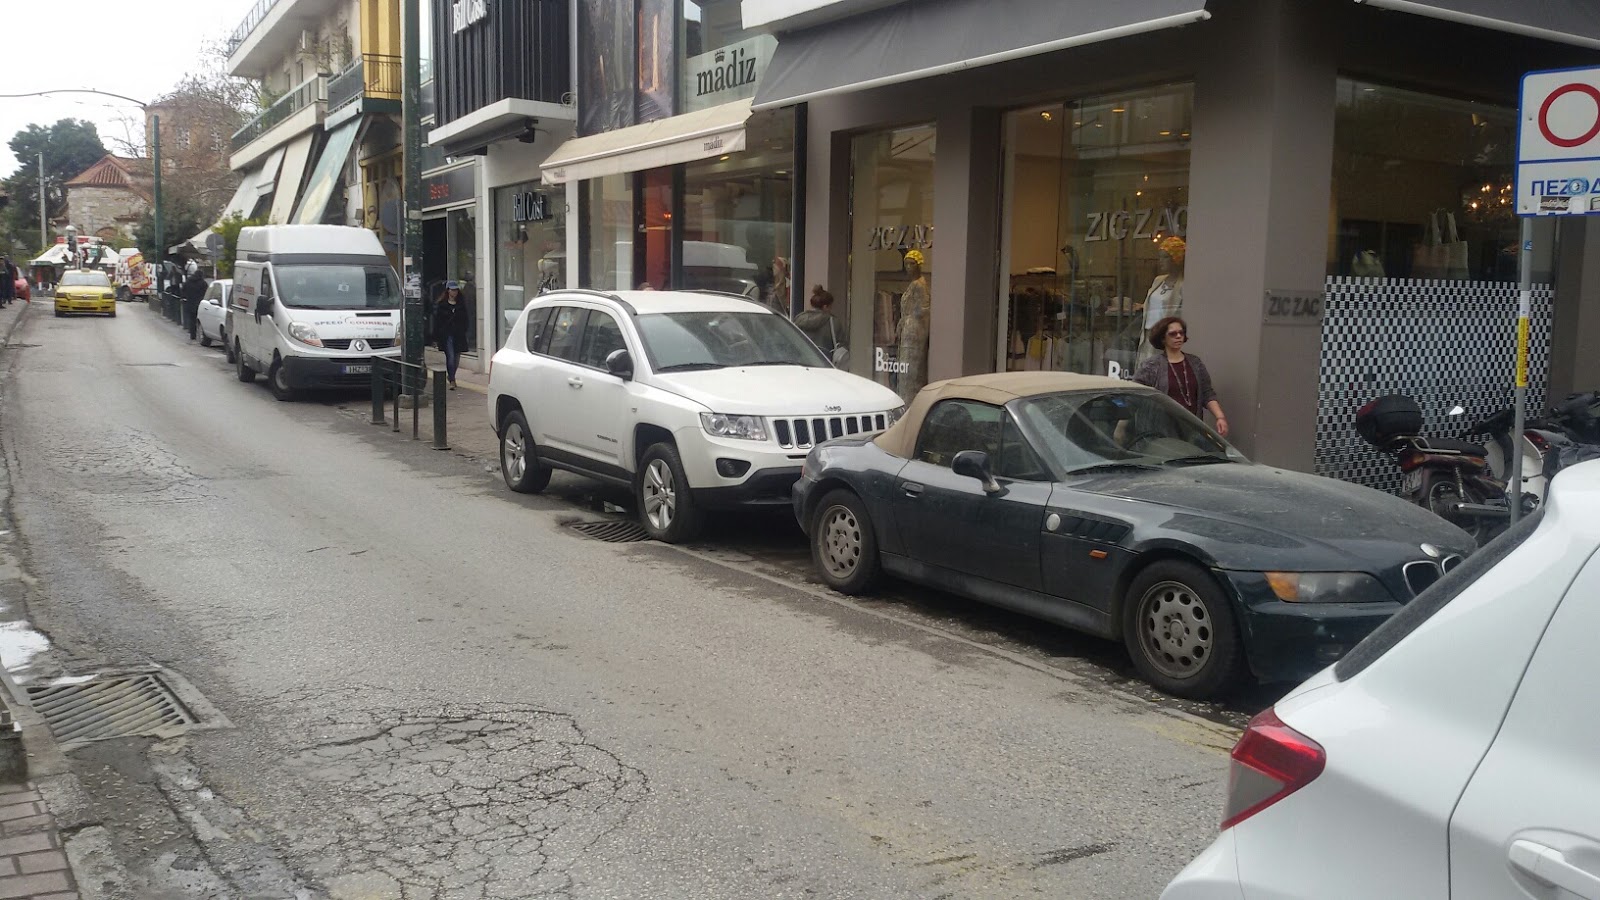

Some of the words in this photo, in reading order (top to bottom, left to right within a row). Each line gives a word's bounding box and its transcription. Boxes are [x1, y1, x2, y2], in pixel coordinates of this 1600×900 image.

[453, 0, 468, 34] Bill
[696, 47, 756, 97] madiz
[703, 135, 723, 151] madiz
[513, 192, 526, 221] Bill
[526, 191, 544, 220] Cost
[1084, 210, 1131, 242] ZIC
[1268, 296, 1291, 317] ZIC
[1292, 297, 1320, 317] ZAC
[875, 346, 909, 374] Bazaar
